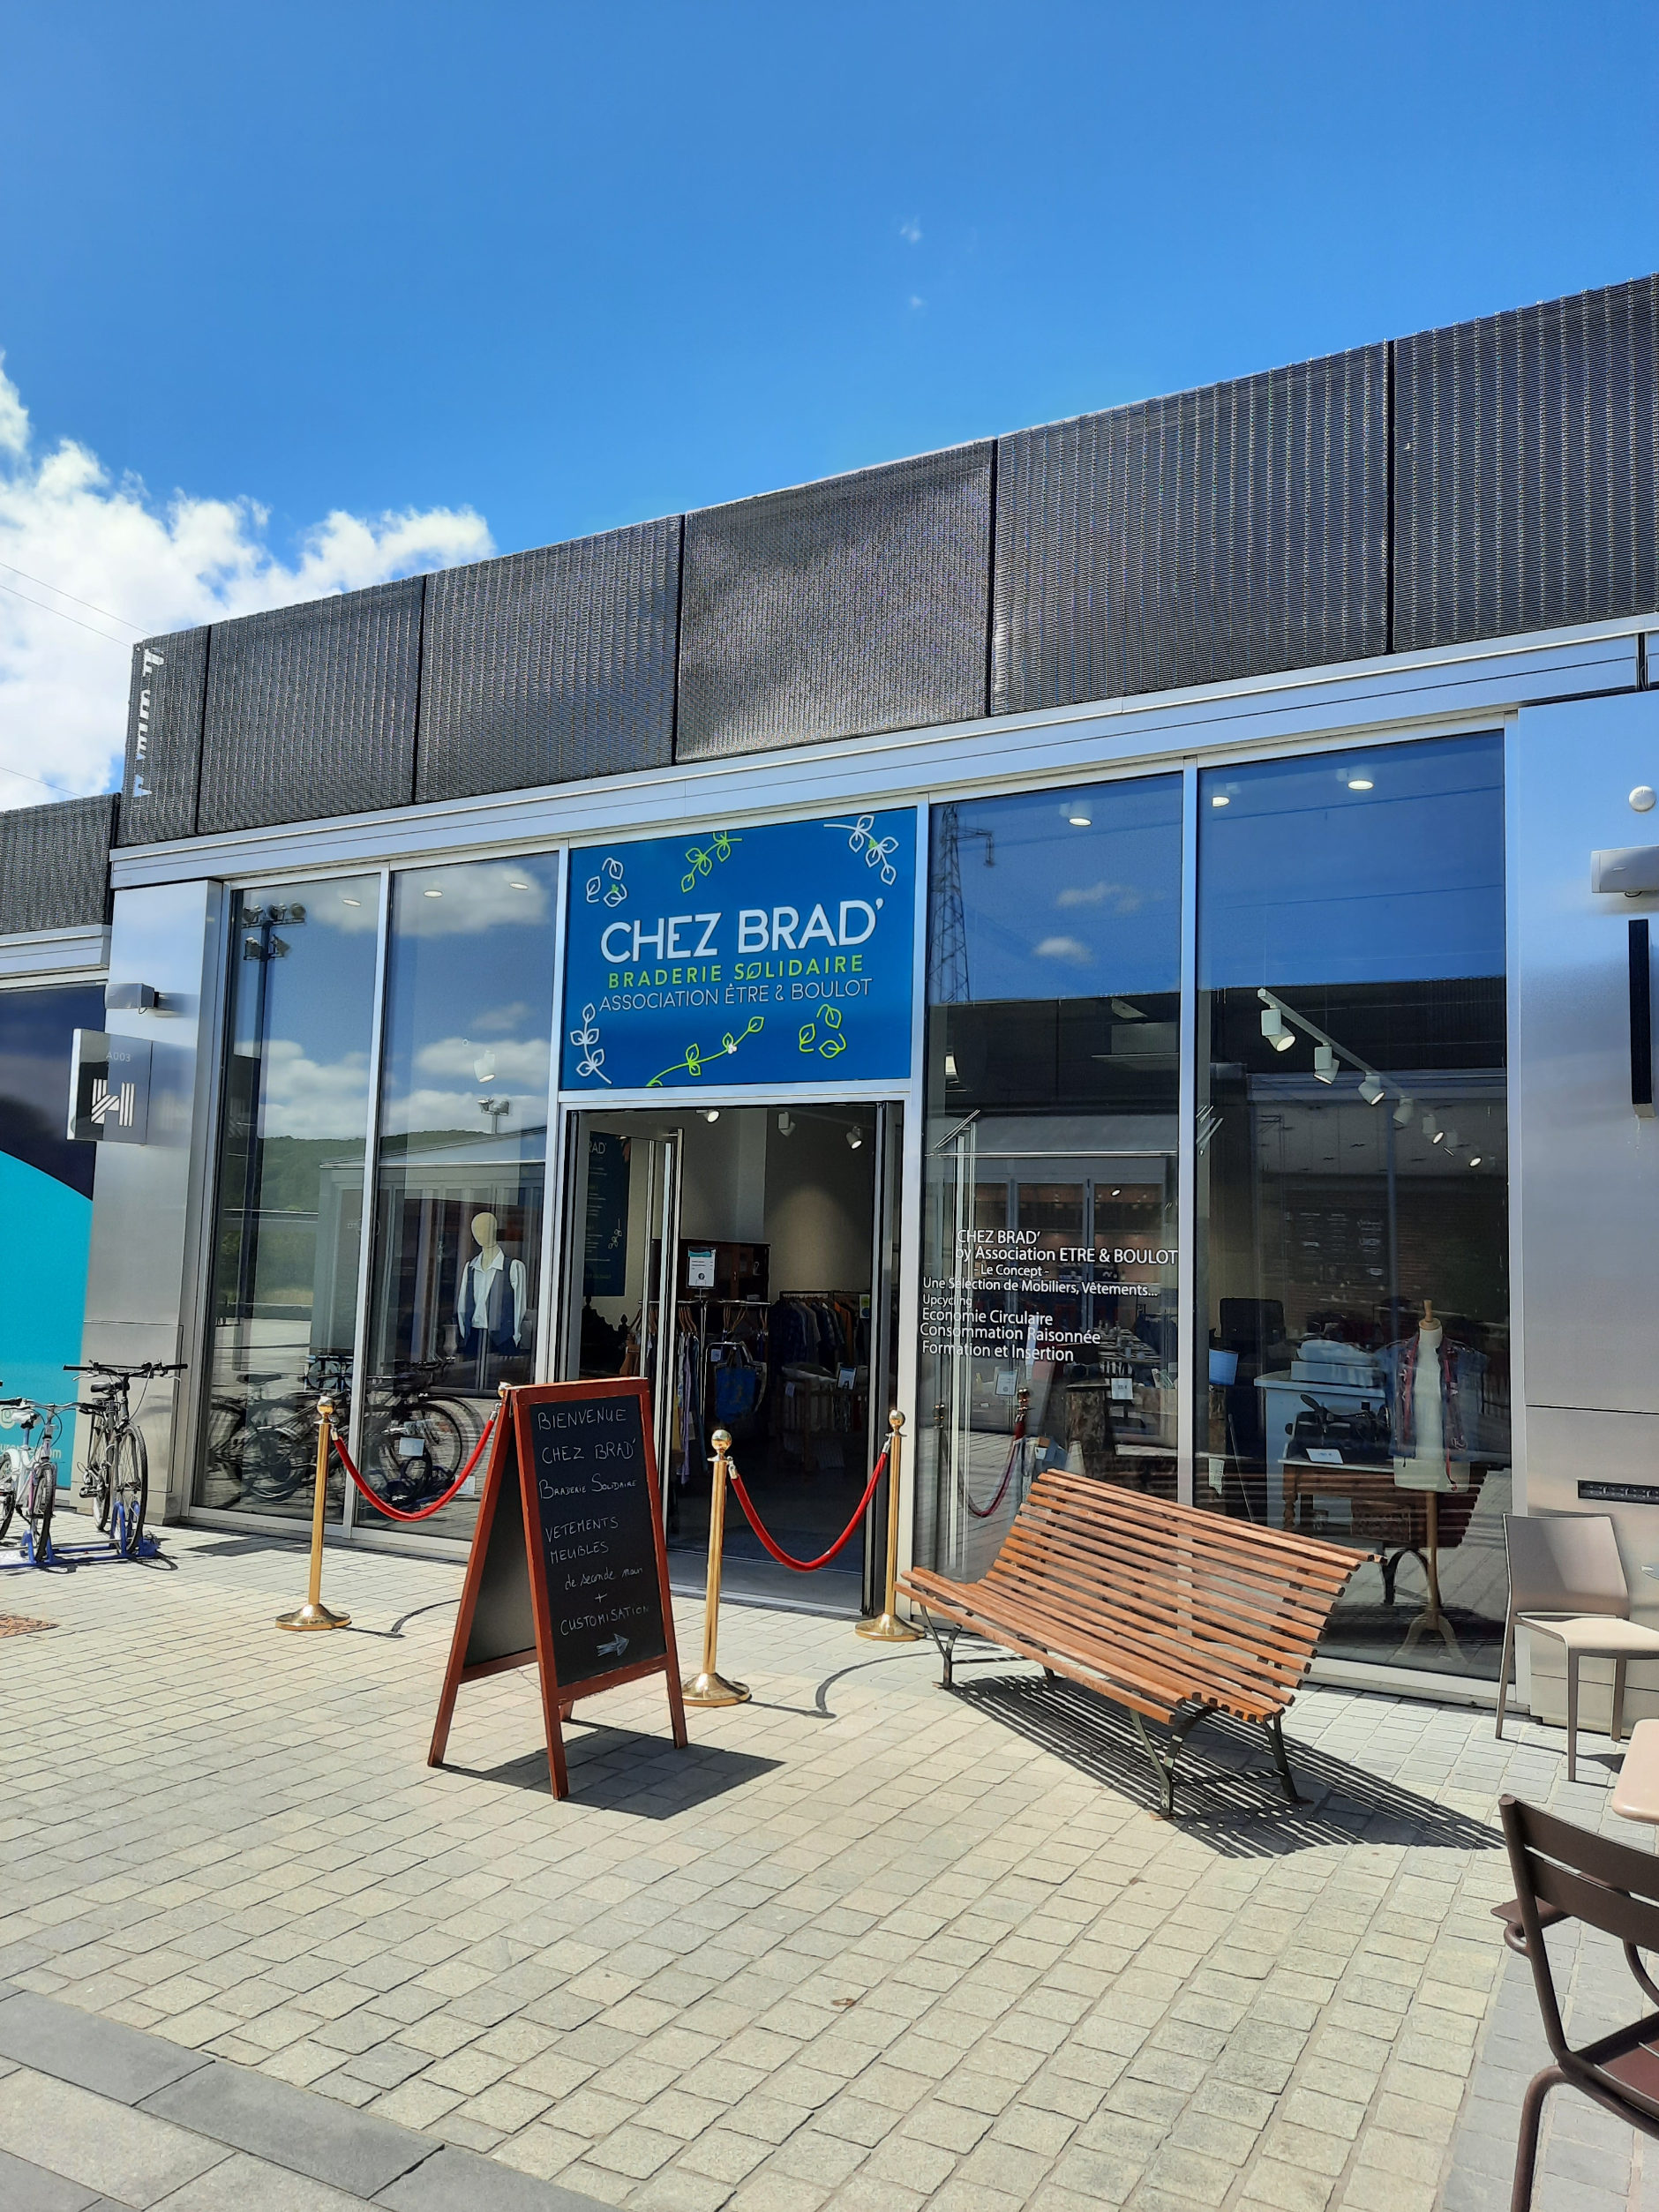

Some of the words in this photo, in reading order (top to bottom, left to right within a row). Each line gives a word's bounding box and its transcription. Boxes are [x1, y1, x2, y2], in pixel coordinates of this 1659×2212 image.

[600, 912, 722, 963] CHEZ
[608, 965, 722, 988] BRADERIE
[734, 954, 863, 981] SOLIDAIRE
[599, 988, 718, 1011] ASSOCIATION
[725, 983, 769, 1004] ÊTRE
[775, 985, 784, 1001] &
[792, 979, 873, 1000] BOULOT
[106, 1051, 131, 1062] A003
[957, 1229, 994, 1243] CHEZ
[997, 1230, 1040, 1244] BRAD'
[956, 1245, 971, 1262] by
[975, 1246, 1055, 1262] Association
[1060, 1248, 1095, 1262] ETRE
[1099, 1248, 1110, 1263] &
[1115, 1248, 1178, 1264] BOULOT
[980, 1263, 993, 1275] Le
[995, 1264, 1043, 1278] Concept
[923, 1277, 946, 1289] Une
[949, 1277, 1001, 1290] Sélection
[1003, 1278, 1018, 1290] de
[1022, 1279, 1079, 1294] Mobiliers,
[1081, 1282, 1159, 1296] Vêtements...
[923, 1294, 972, 1308] Upcycling
[923, 1308, 987, 1323] Economie
[989, 1310, 1053, 1325] Circulaire
[920, 1323, 1023, 1340] Consommation
[1027, 1327, 1101, 1344] Raisonnée
[922, 1340, 991, 1357] Formation
[994, 1346, 1009, 1358] et
[1012, 1345, 1074, 1361] Insertion
[537, 1409, 627, 1430] BIENVENUE
[542, 1446, 584, 1465] CHEZ
[545, 1517, 619, 1542] VETEMENTS
[550, 1541, 609, 1564] MEUBLES
[565, 1572, 577, 1591] de
[580, 1566, 616, 1586] seconde
[560, 1605, 649, 1636] CUSTOMISATION
